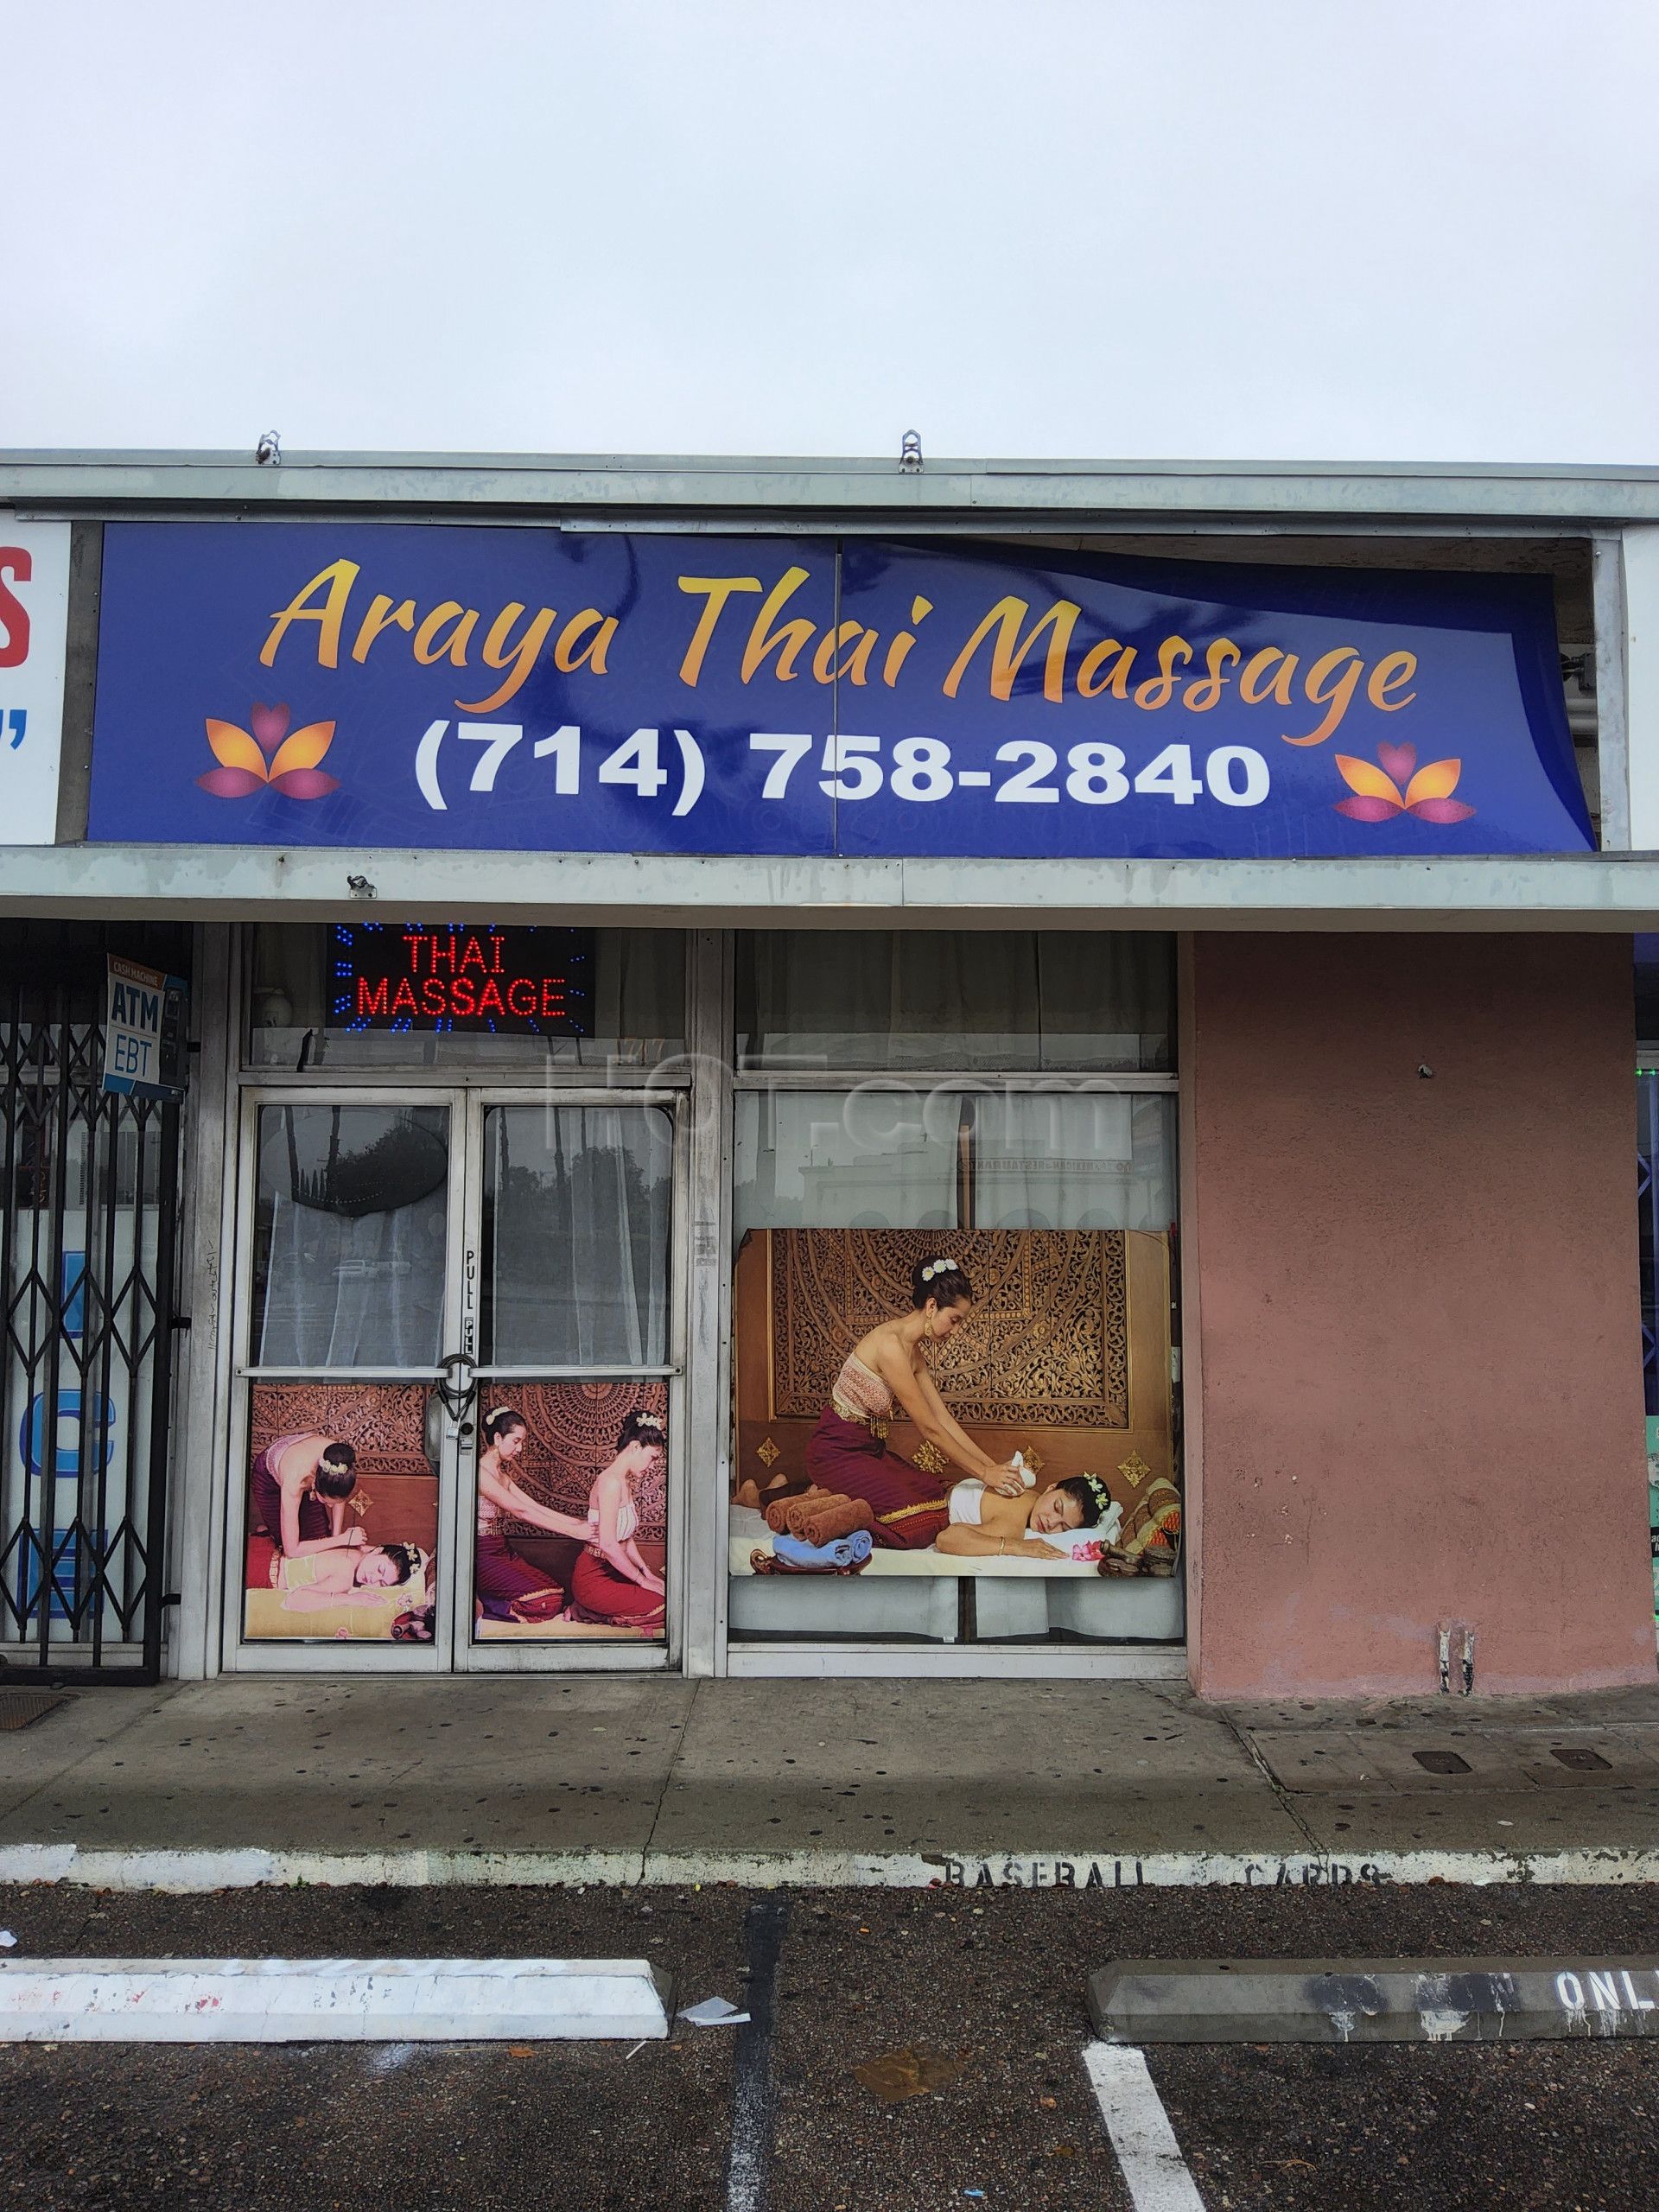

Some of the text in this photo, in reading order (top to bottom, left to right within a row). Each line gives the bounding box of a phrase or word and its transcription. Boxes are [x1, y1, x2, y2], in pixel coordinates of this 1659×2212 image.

[259, 558, 1418, 747] Araya Thai Massage
[415, 720, 1270, 817] (714) 758-2840
[113, 960, 158, 988] CASH MACHINE
[401, 934, 505, 974] THAI
[111, 982, 159, 1033] ATM
[356, 976, 566, 1016] MASSAGE
[114, 1033, 152, 1077] EBT
[466, 1249, 475, 1310] PULL
[464, 1319, 474, 1355] PULL
[945, 1860, 1144, 1889] BASEBALL
[1556, 1970, 1659, 2010] ONL
